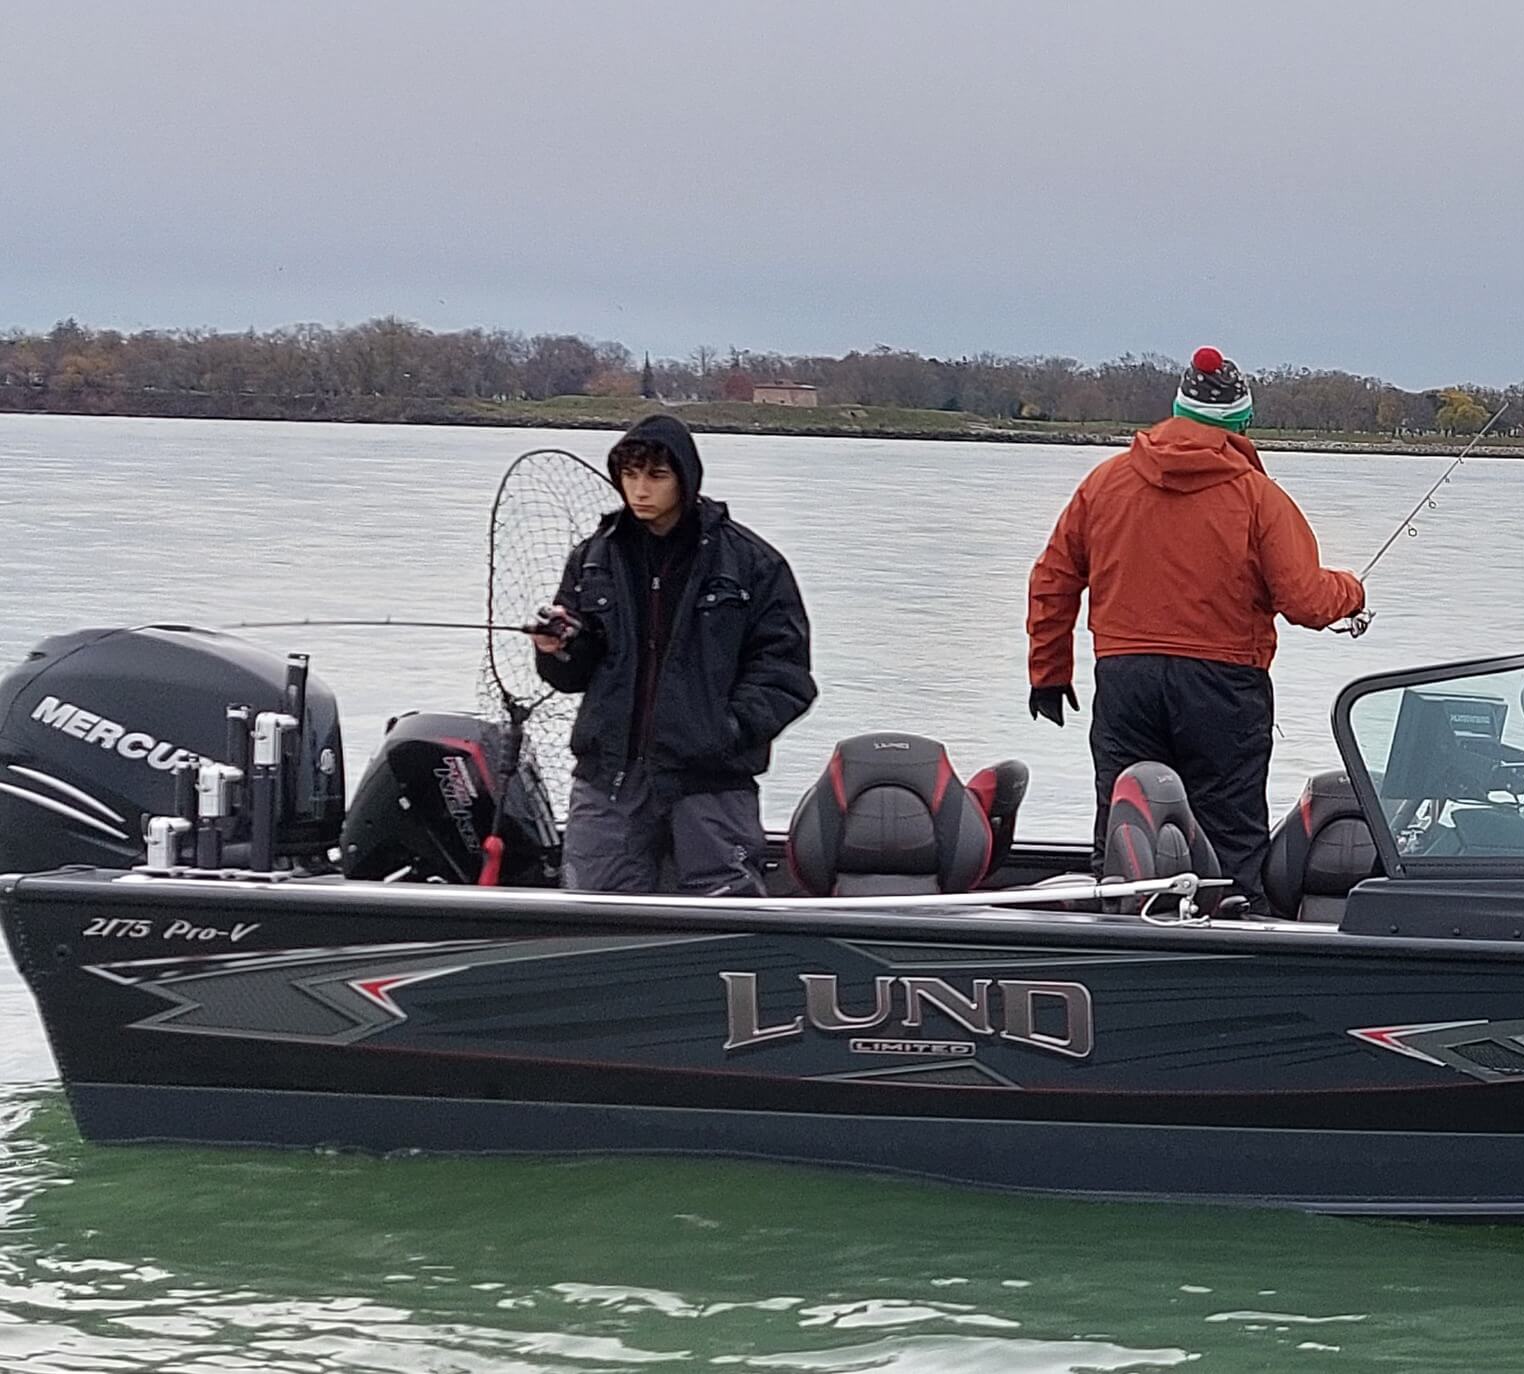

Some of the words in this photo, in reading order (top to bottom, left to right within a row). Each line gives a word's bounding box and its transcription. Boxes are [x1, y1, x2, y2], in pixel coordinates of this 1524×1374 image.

[31, 696, 214, 776] MERCU
[82, 917, 154, 938] 2175
[162, 918, 262, 943] Pro-V
[719, 971, 1094, 1058] LUND
[854, 1040, 971, 1055] LIMITED
